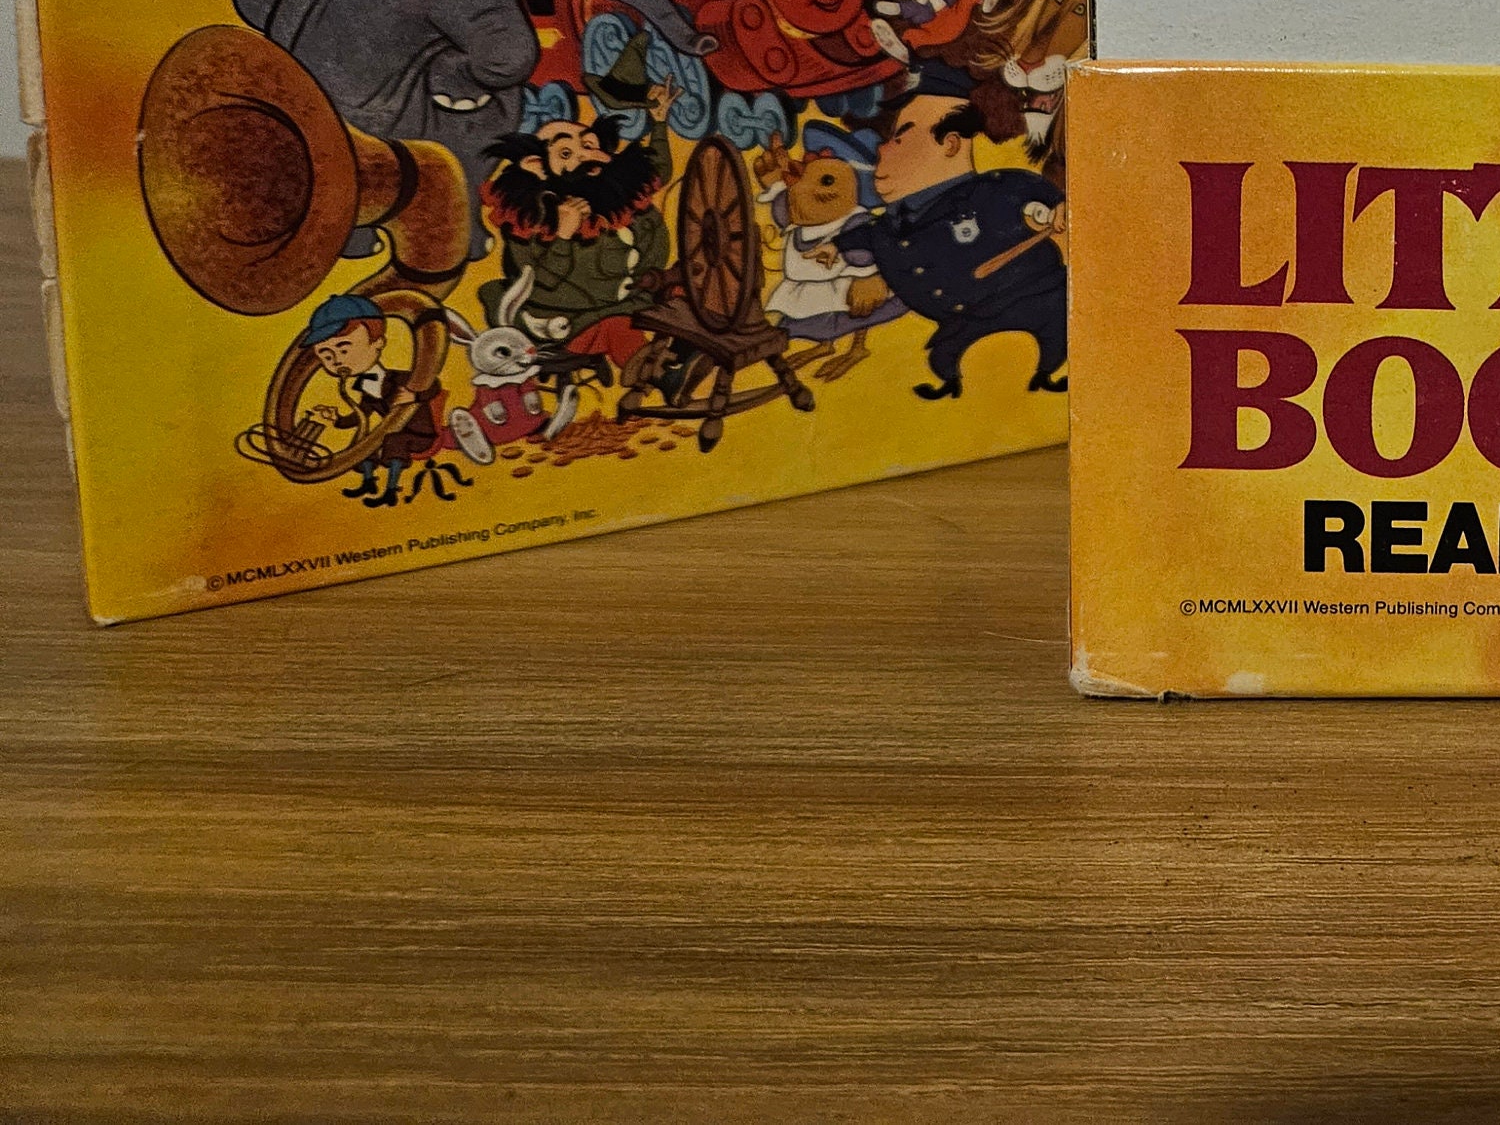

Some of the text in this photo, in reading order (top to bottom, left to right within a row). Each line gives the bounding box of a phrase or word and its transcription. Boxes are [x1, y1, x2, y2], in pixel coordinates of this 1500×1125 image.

[335, 544, 404, 566] Western
[408, 525, 491, 552] Publishing
[1303, 601, 1370, 615] Western
[1375, 601, 1458, 618] Publishing
